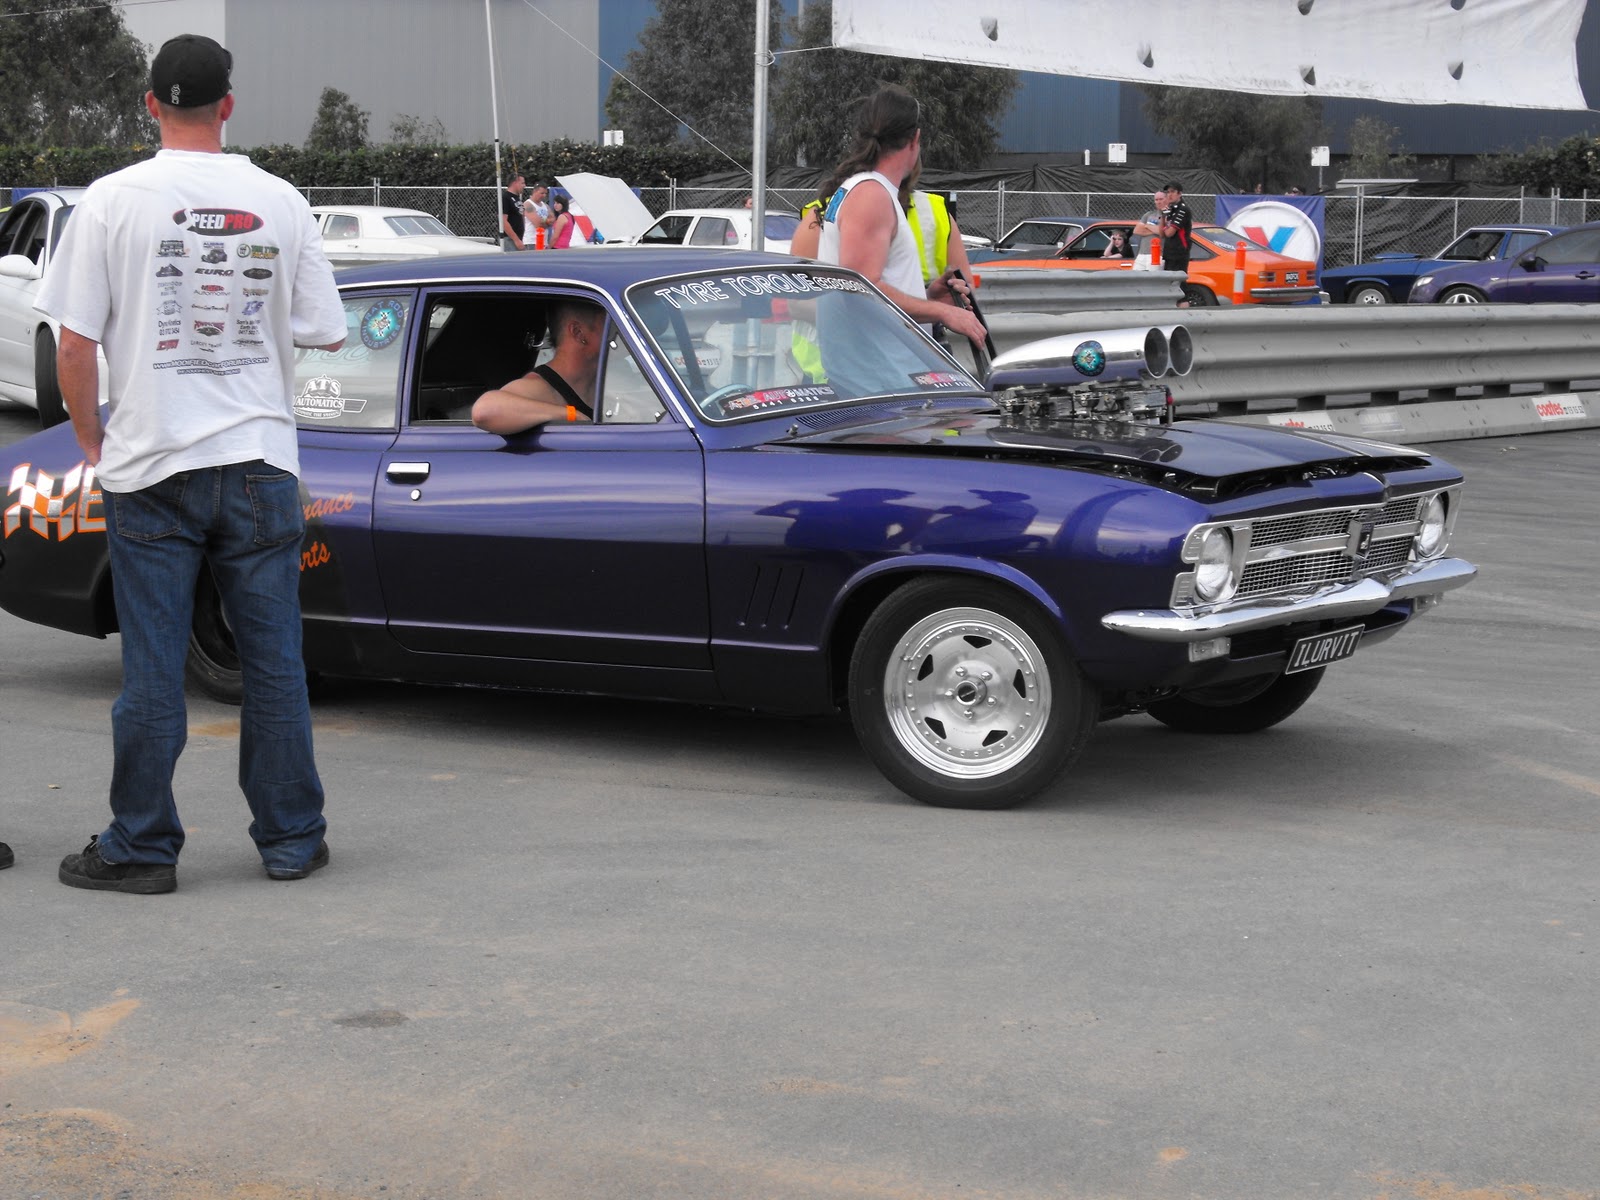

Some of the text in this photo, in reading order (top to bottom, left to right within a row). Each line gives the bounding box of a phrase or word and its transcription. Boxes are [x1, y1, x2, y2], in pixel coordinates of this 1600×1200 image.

[654, 280, 729, 309] TYRE
[721, 273, 823, 297] TORQUE
[388, 300, 404, 318] ROD
[305, 379, 340, 396] ATS
[295, 397, 343, 408] AUTOMATICS
[1293, 631, 1360, 668] ILURVIT
